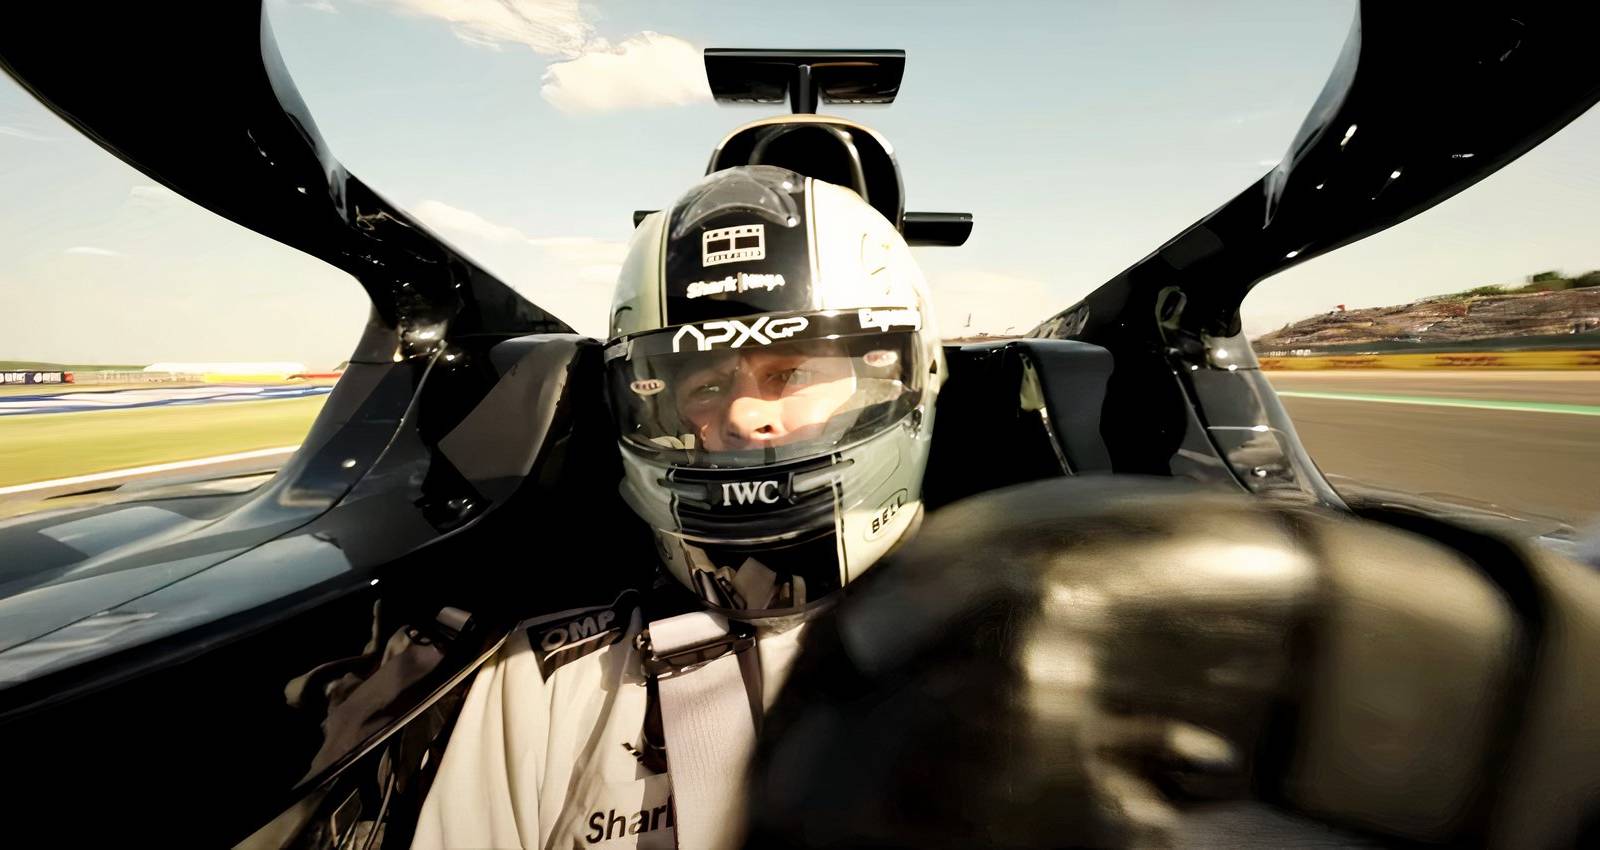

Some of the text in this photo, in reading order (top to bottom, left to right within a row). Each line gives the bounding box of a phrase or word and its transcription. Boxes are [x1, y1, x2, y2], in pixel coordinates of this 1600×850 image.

[721, 480, 780, 506] IWC
[871, 495, 905, 534] BELL
[541, 610, 615, 651] OMP
